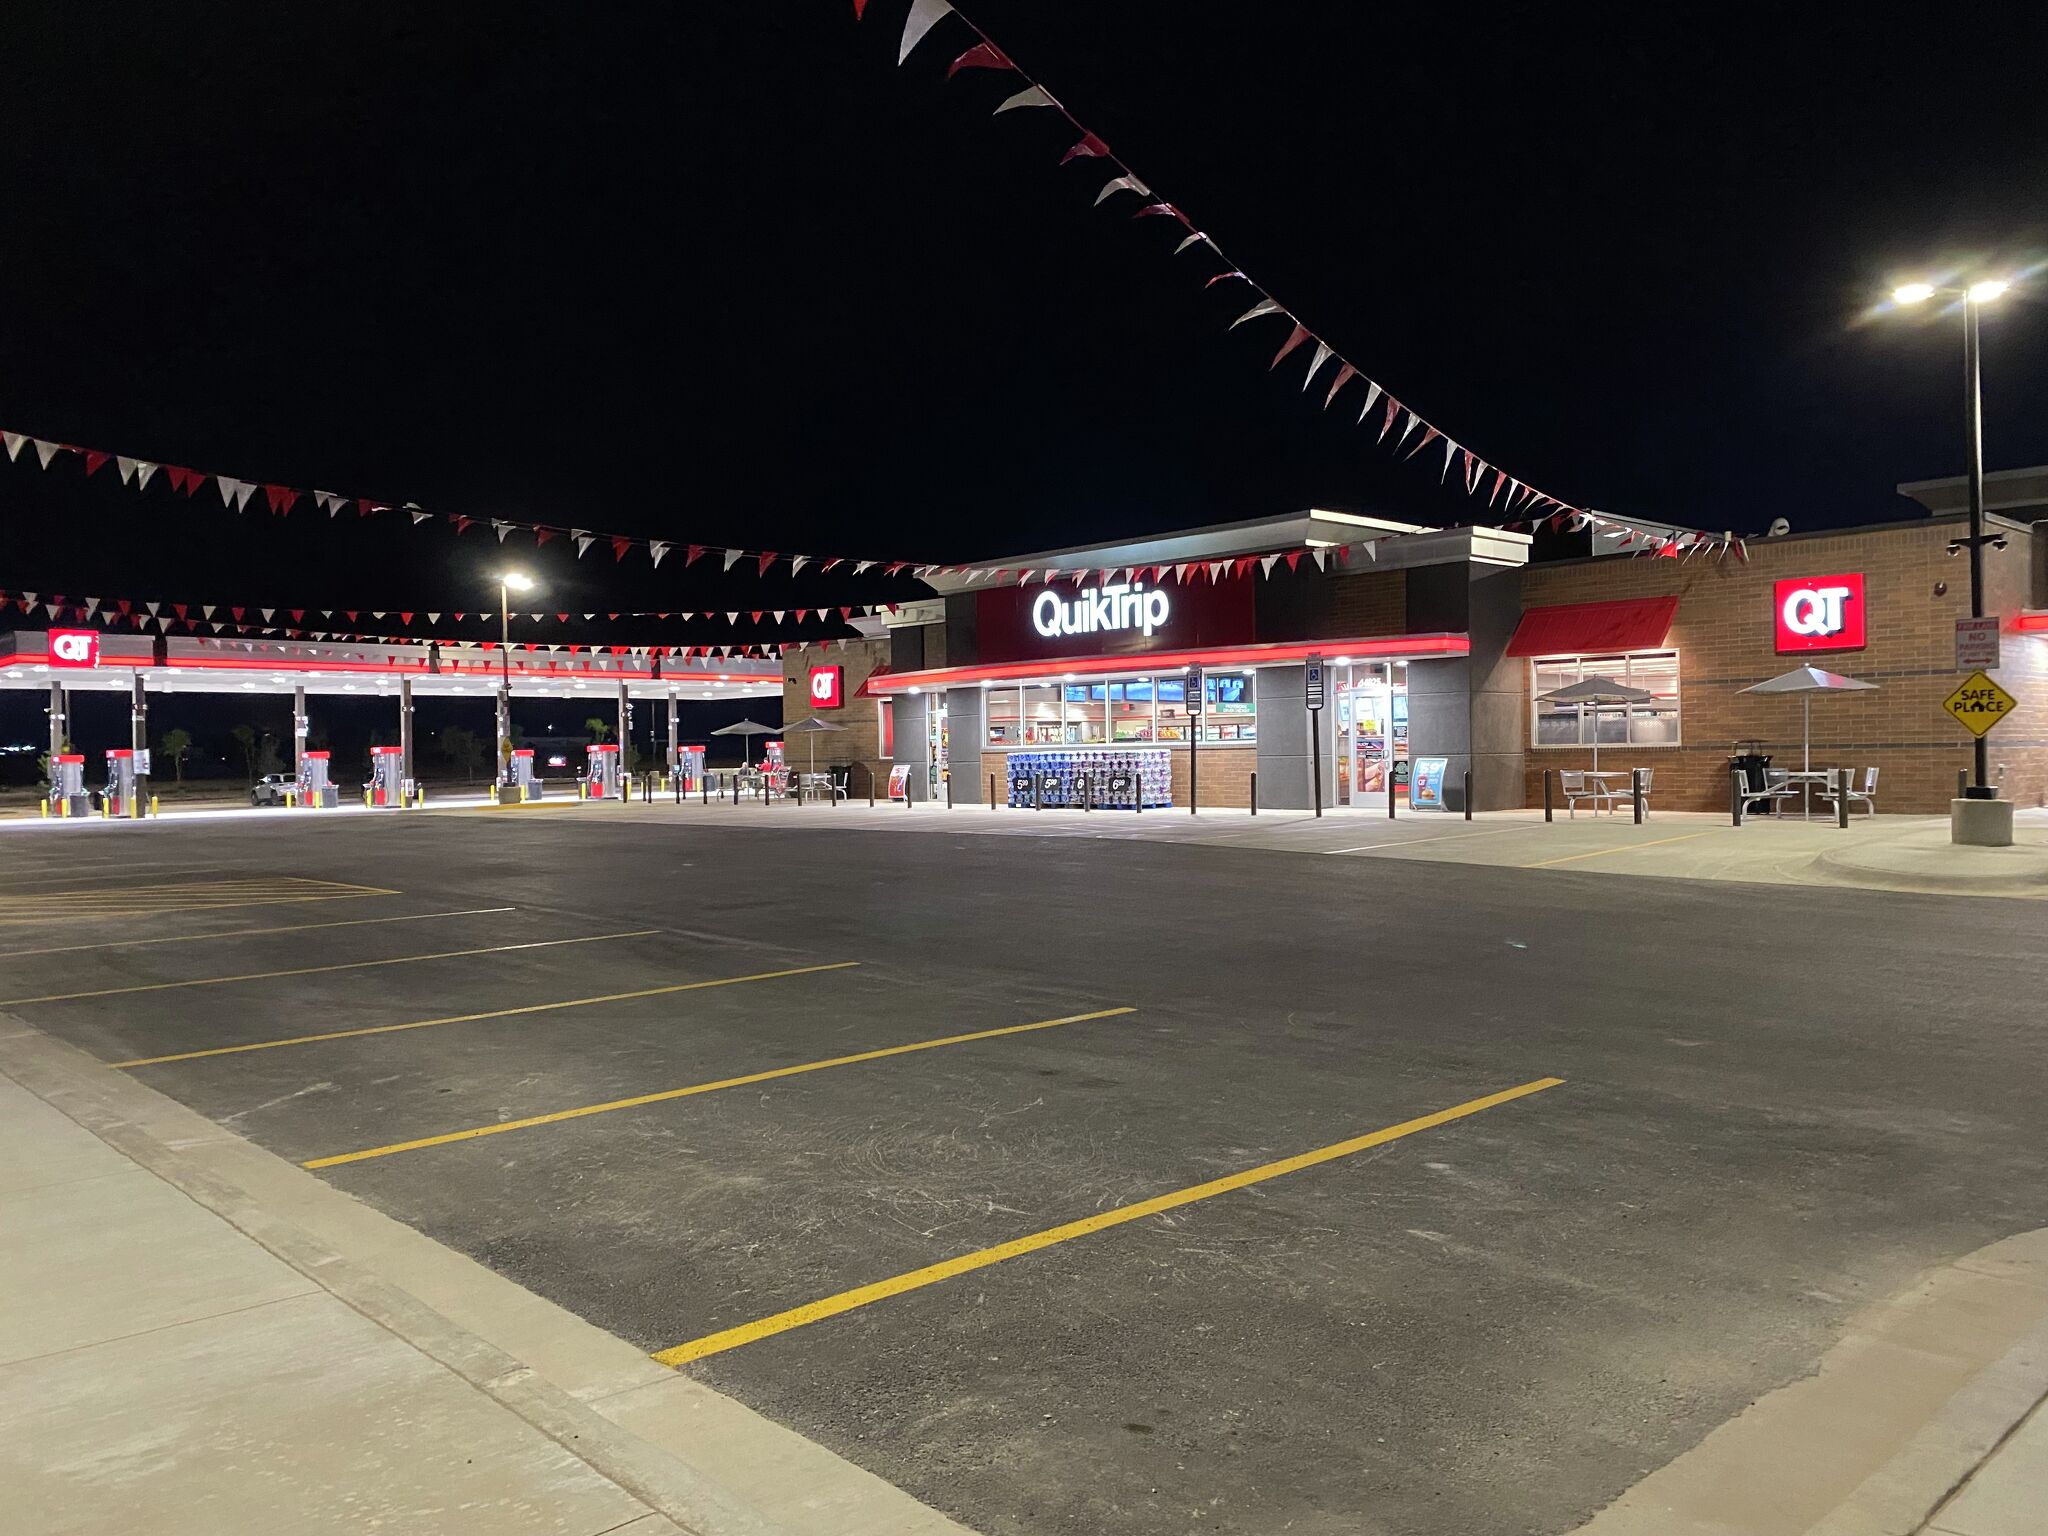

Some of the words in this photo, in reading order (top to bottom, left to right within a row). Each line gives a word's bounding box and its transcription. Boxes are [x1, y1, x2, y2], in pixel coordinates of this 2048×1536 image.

[1033, 582, 1169, 637] QuikTrip
[1783, 587, 1849, 636] QT
[53, 634, 92, 662] QT
[1968, 633, 1986, 641] NO
[812, 672, 834, 700] QT
[1961, 689, 1995, 700] SAFE
